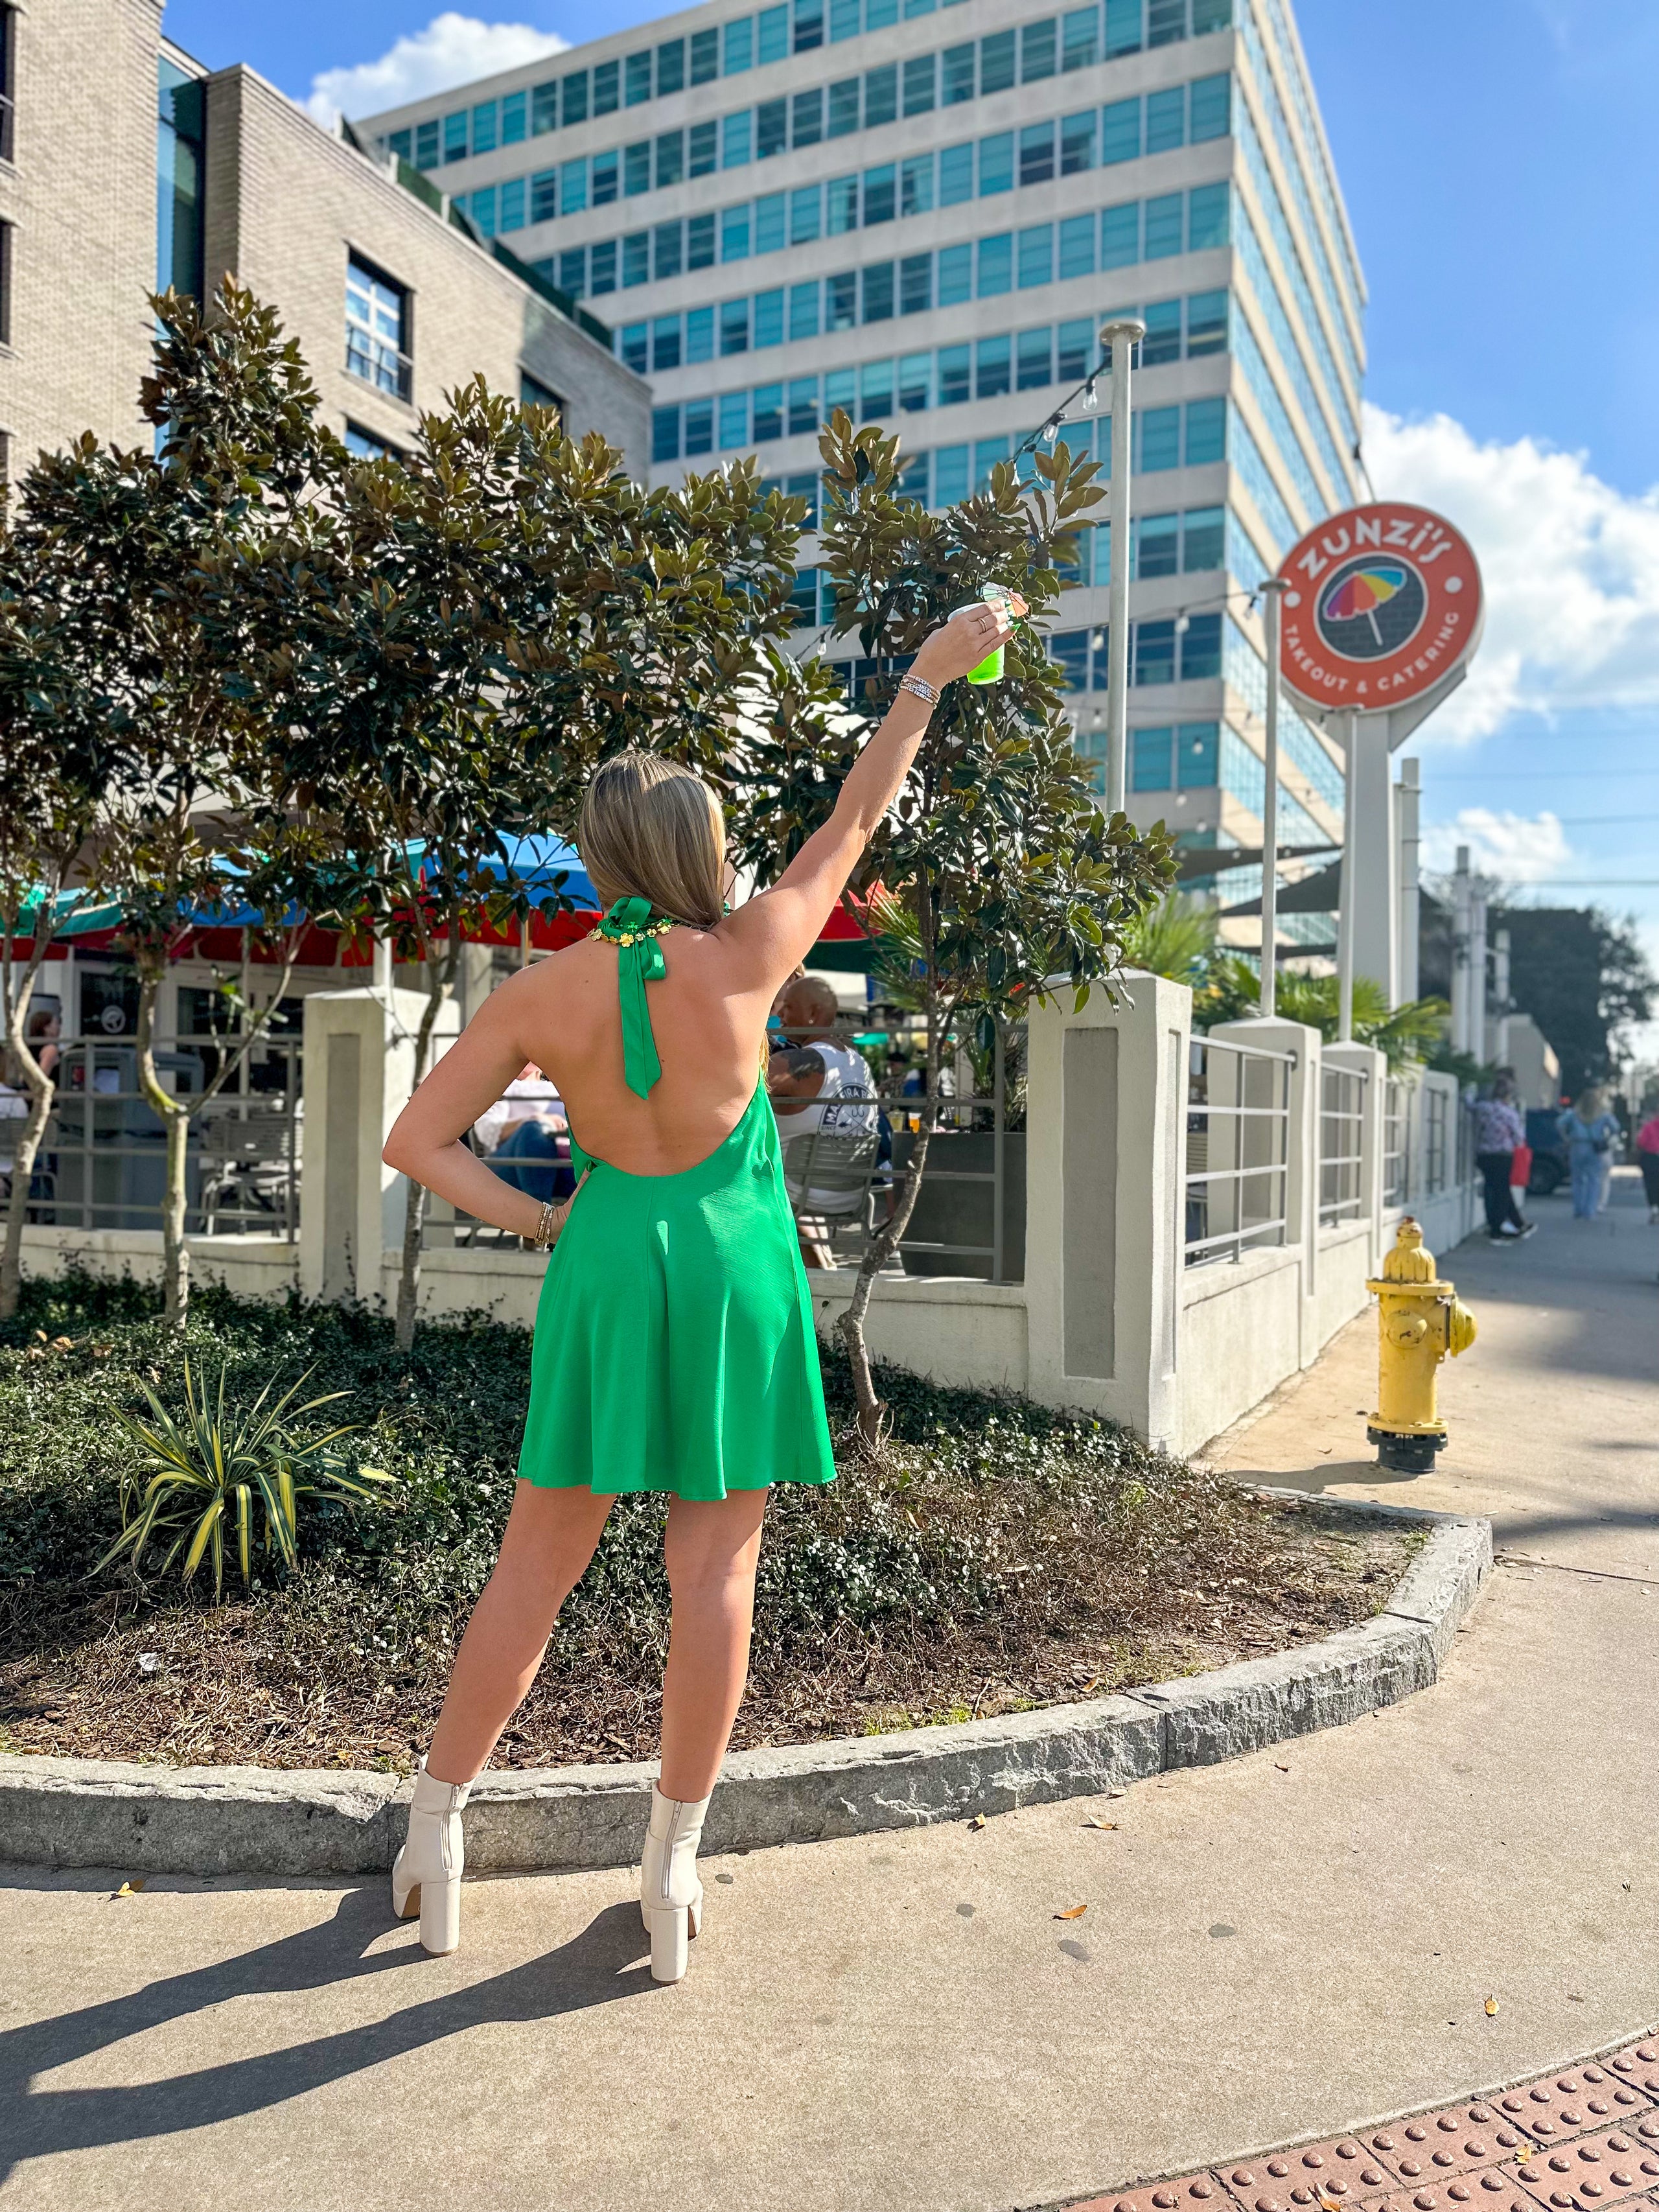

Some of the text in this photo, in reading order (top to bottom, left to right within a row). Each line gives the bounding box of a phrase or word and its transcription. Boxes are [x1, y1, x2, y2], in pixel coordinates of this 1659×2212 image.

[1285, 612, 1459, 694] TAKEOUT & CATERING
